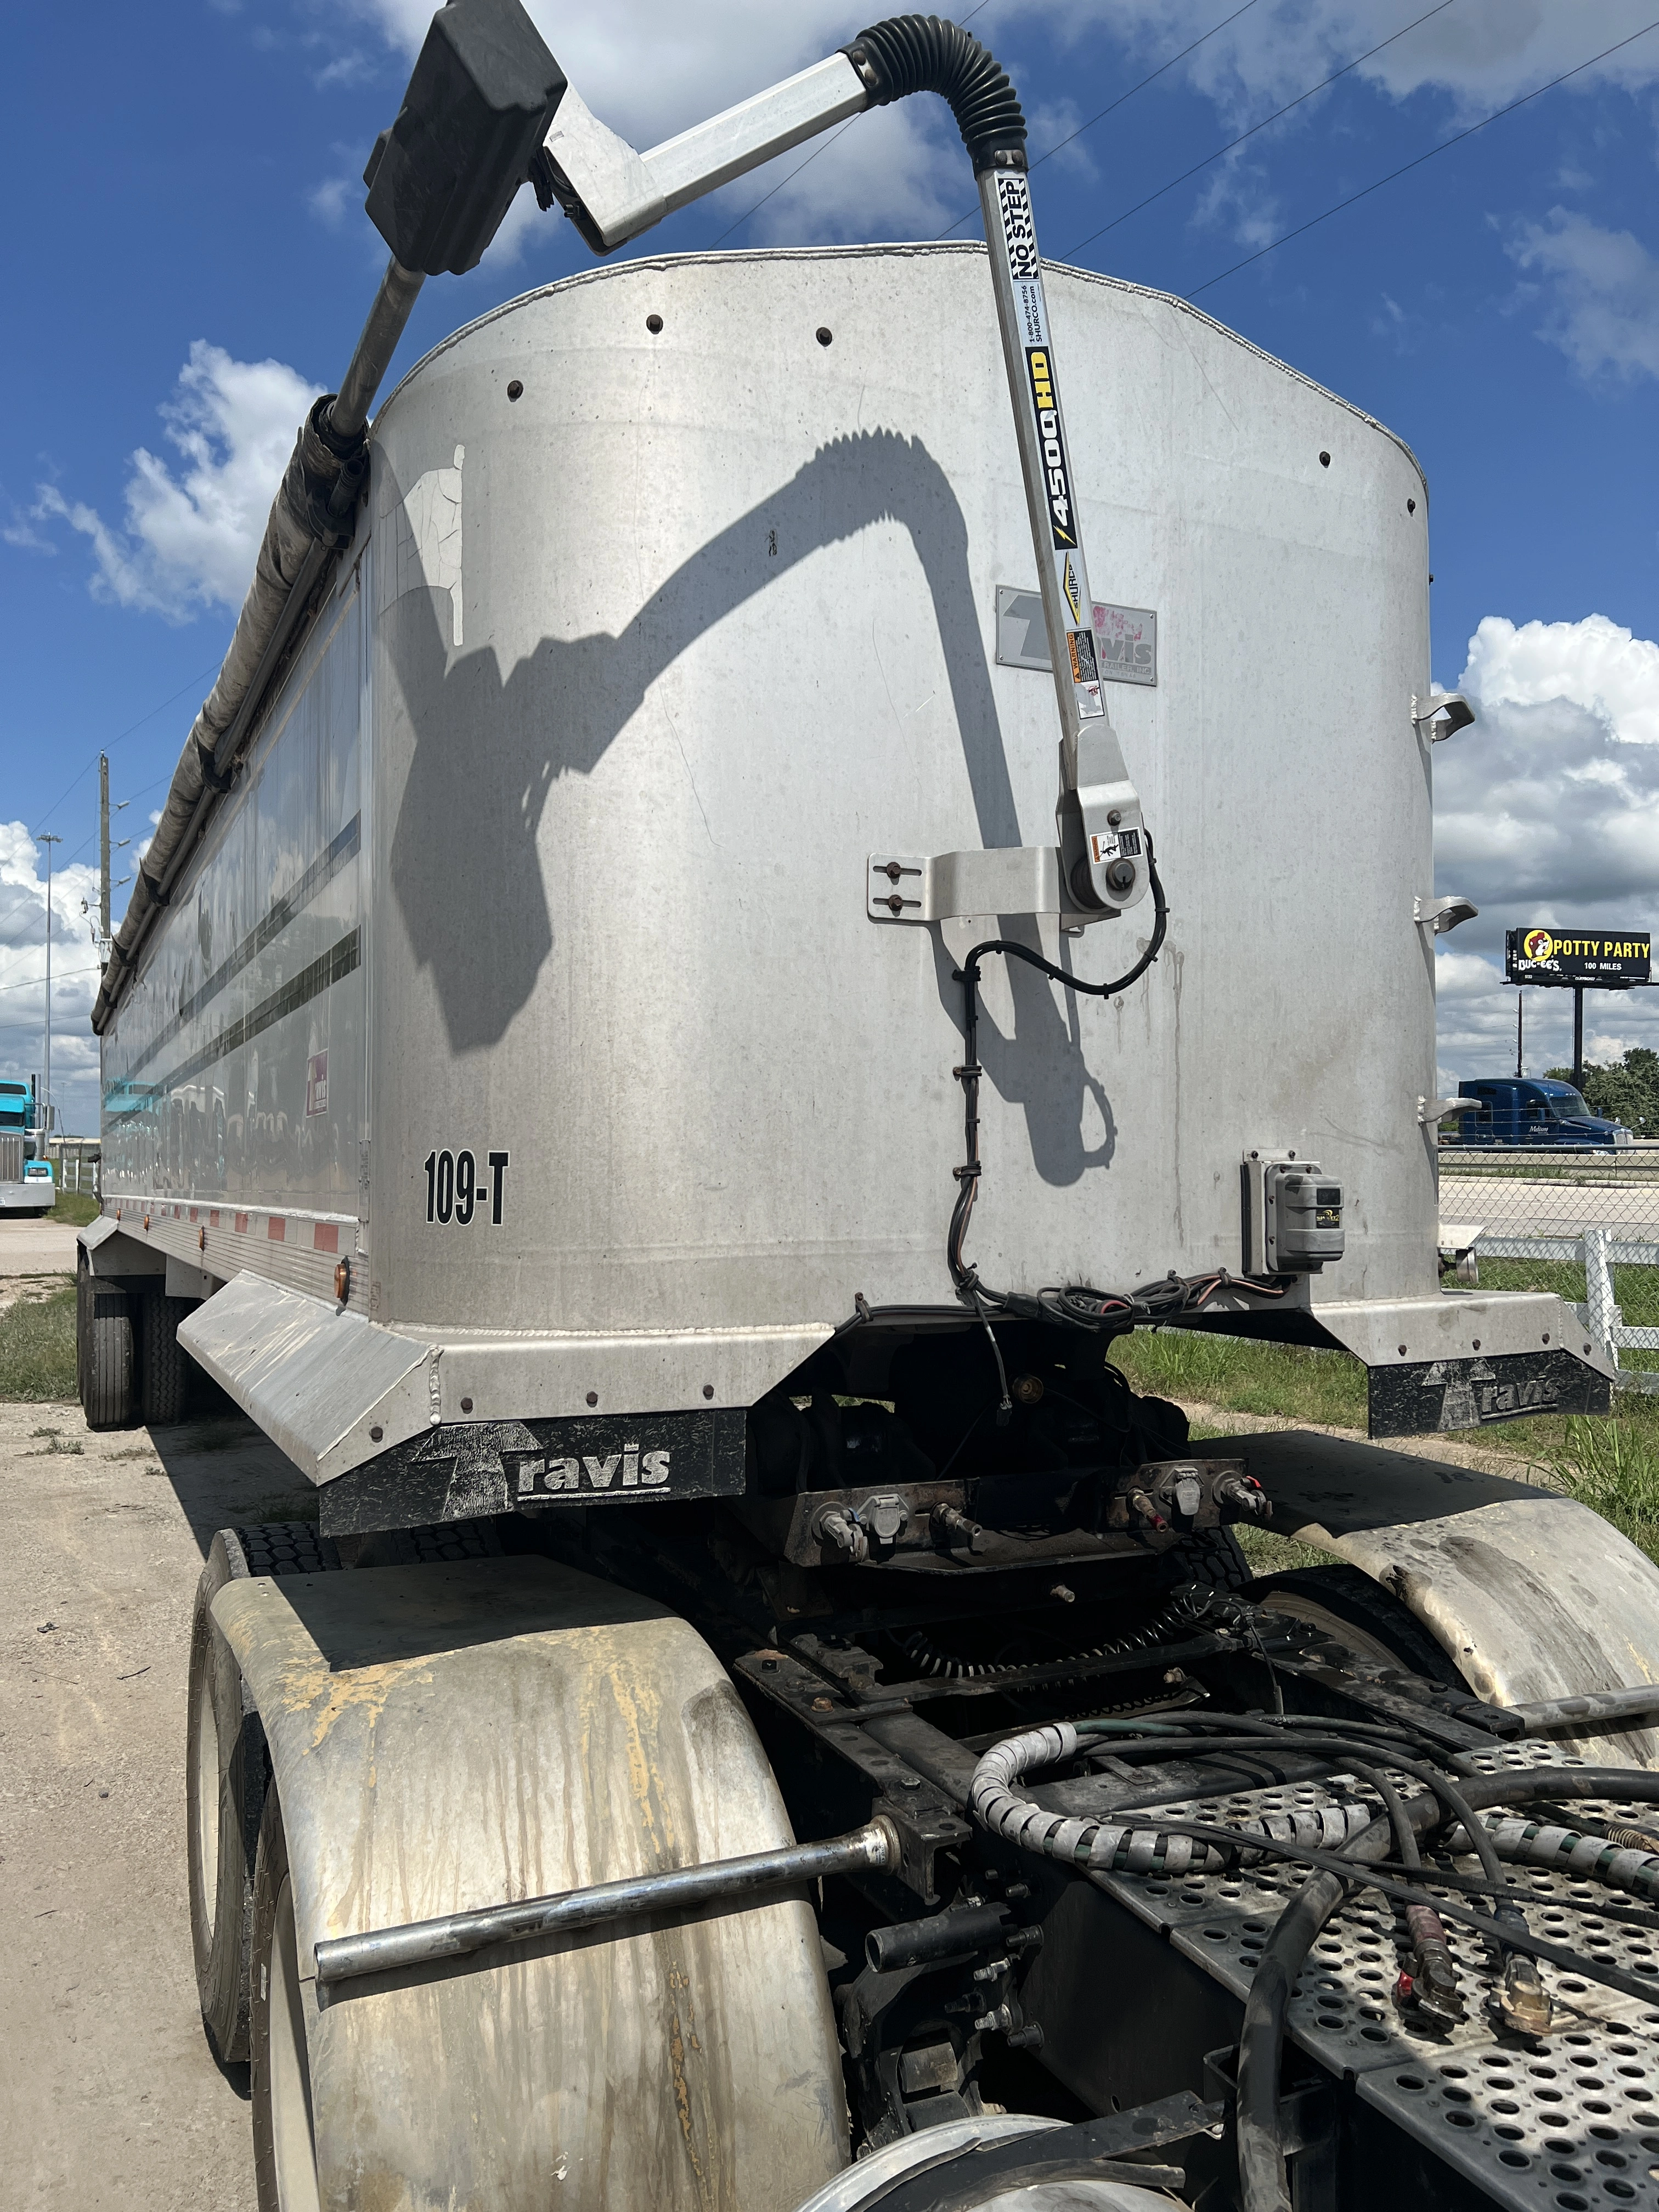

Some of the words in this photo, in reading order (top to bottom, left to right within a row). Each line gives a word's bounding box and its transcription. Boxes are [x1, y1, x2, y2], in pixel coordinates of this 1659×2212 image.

[1006, 181, 1025, 239] STEP
[1015, 245, 1032, 276] NO
[1022, 285, 1035, 343] 1-800-474-8756
[1030, 286, 1042, 342] SHURCO.com
[1069, 634, 1078, 669] WARNING
[1553, 940, 1600, 956] POTTY
[1604, 941, 1650, 958] PARTY
[424, 1148, 510, 1226] 109-T
